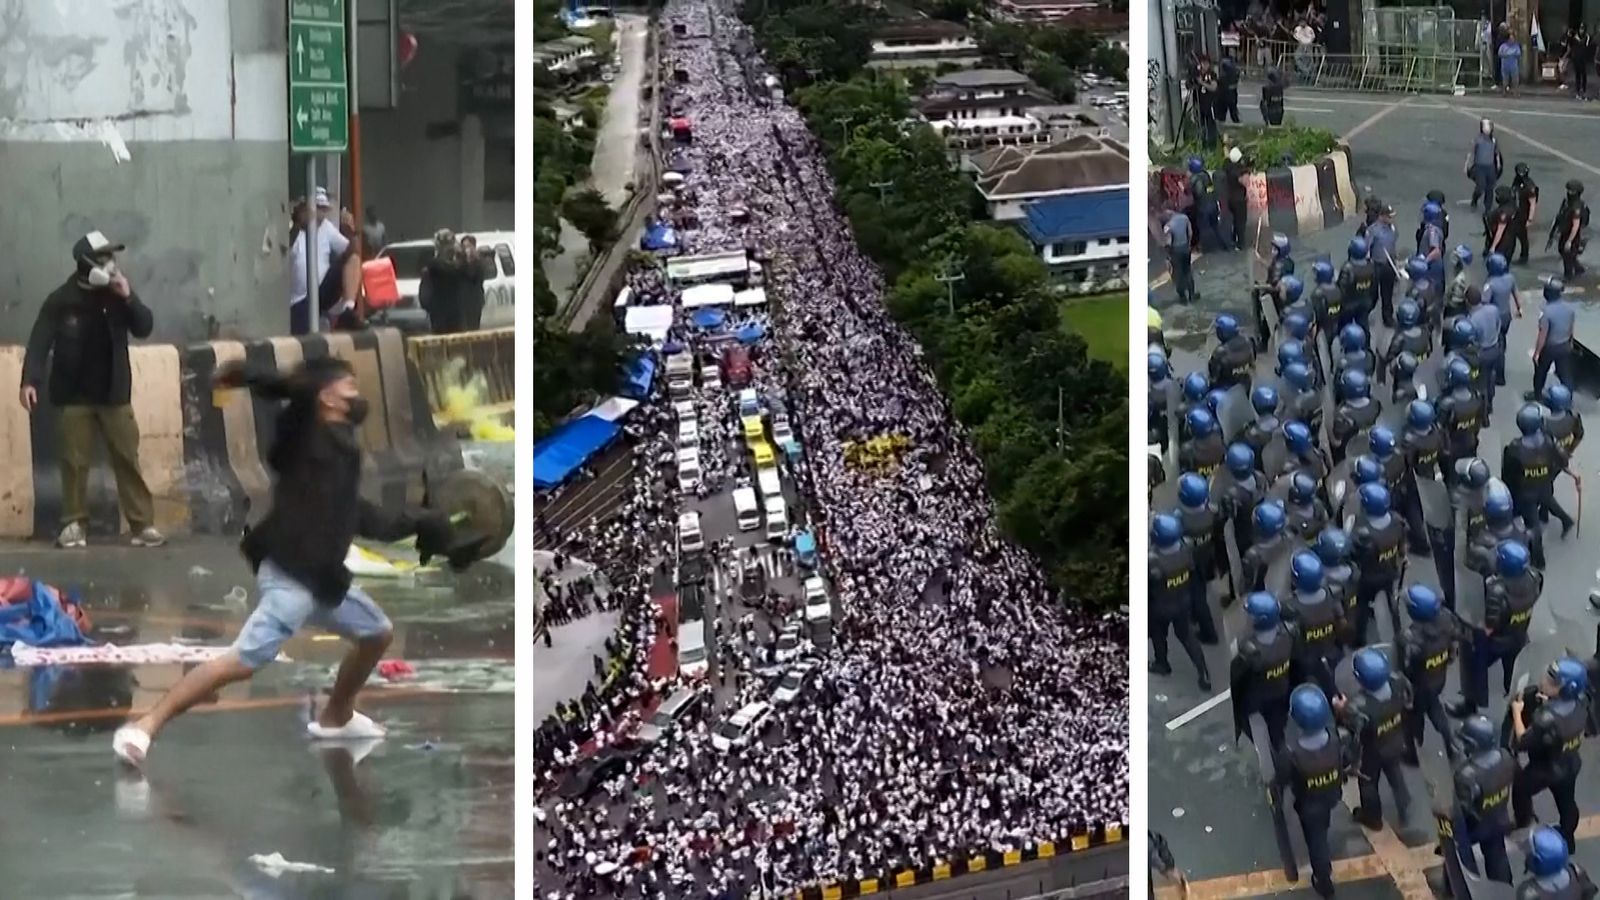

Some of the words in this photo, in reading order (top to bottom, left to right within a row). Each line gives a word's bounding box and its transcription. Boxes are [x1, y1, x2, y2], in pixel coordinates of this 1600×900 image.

[1524, 466, 1549, 479] PULIS
[1306, 623, 1334, 642] PULIS
[1307, 768, 1339, 790] PULIS
